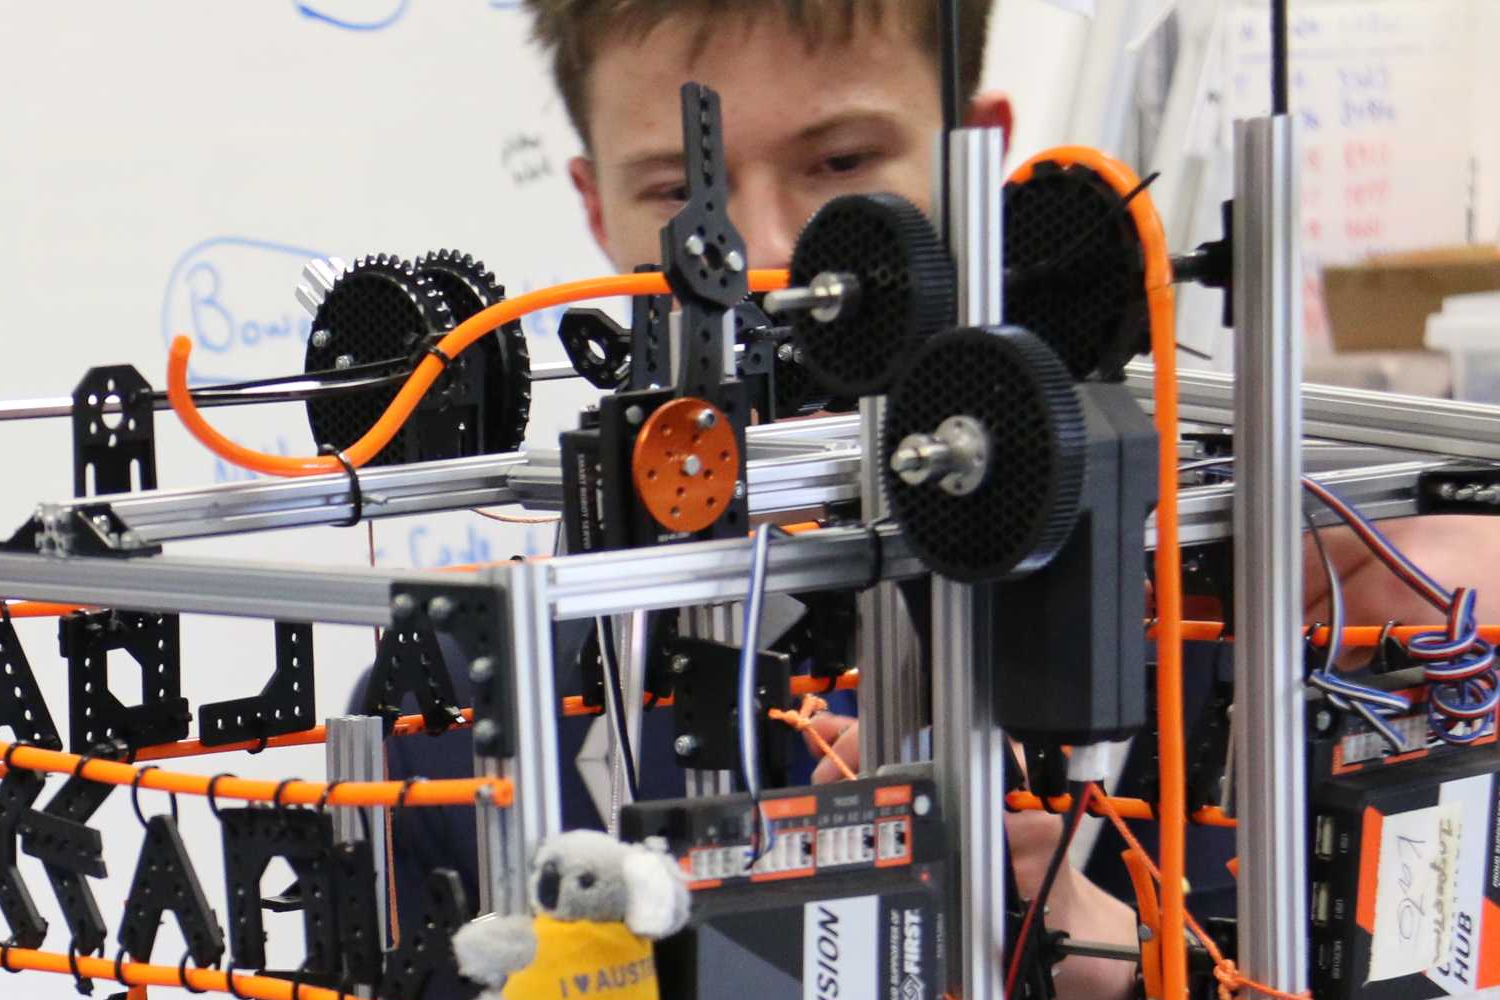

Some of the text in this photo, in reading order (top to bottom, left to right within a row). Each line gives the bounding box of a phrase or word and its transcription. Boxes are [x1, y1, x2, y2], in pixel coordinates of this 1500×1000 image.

[891, 926, 900, 986] SUPPORTER
[902, 908, 922, 977] FIRST
[1454, 912, 1474, 986] HUB
